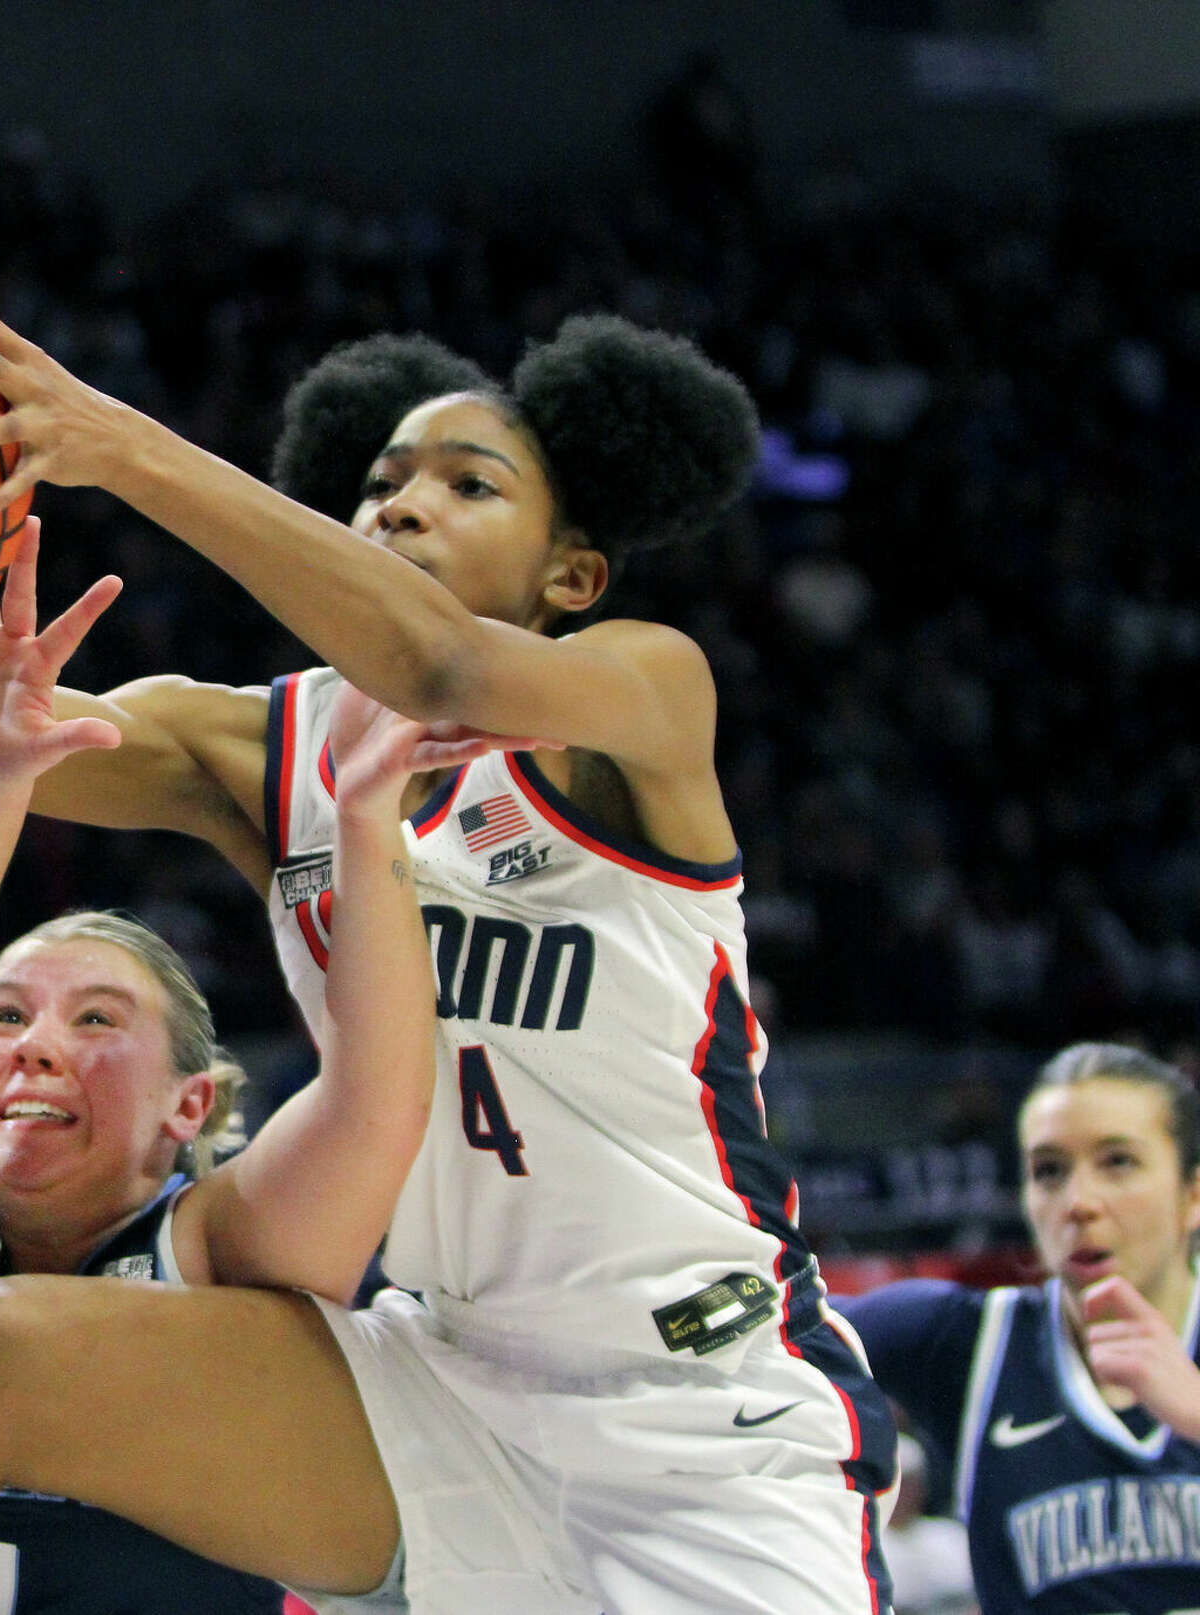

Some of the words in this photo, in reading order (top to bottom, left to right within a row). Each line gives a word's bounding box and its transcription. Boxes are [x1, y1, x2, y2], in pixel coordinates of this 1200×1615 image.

[487, 840, 532, 872] BIG
[487, 845, 552, 881] EAST
[459, 1044, 530, 1176] 4
